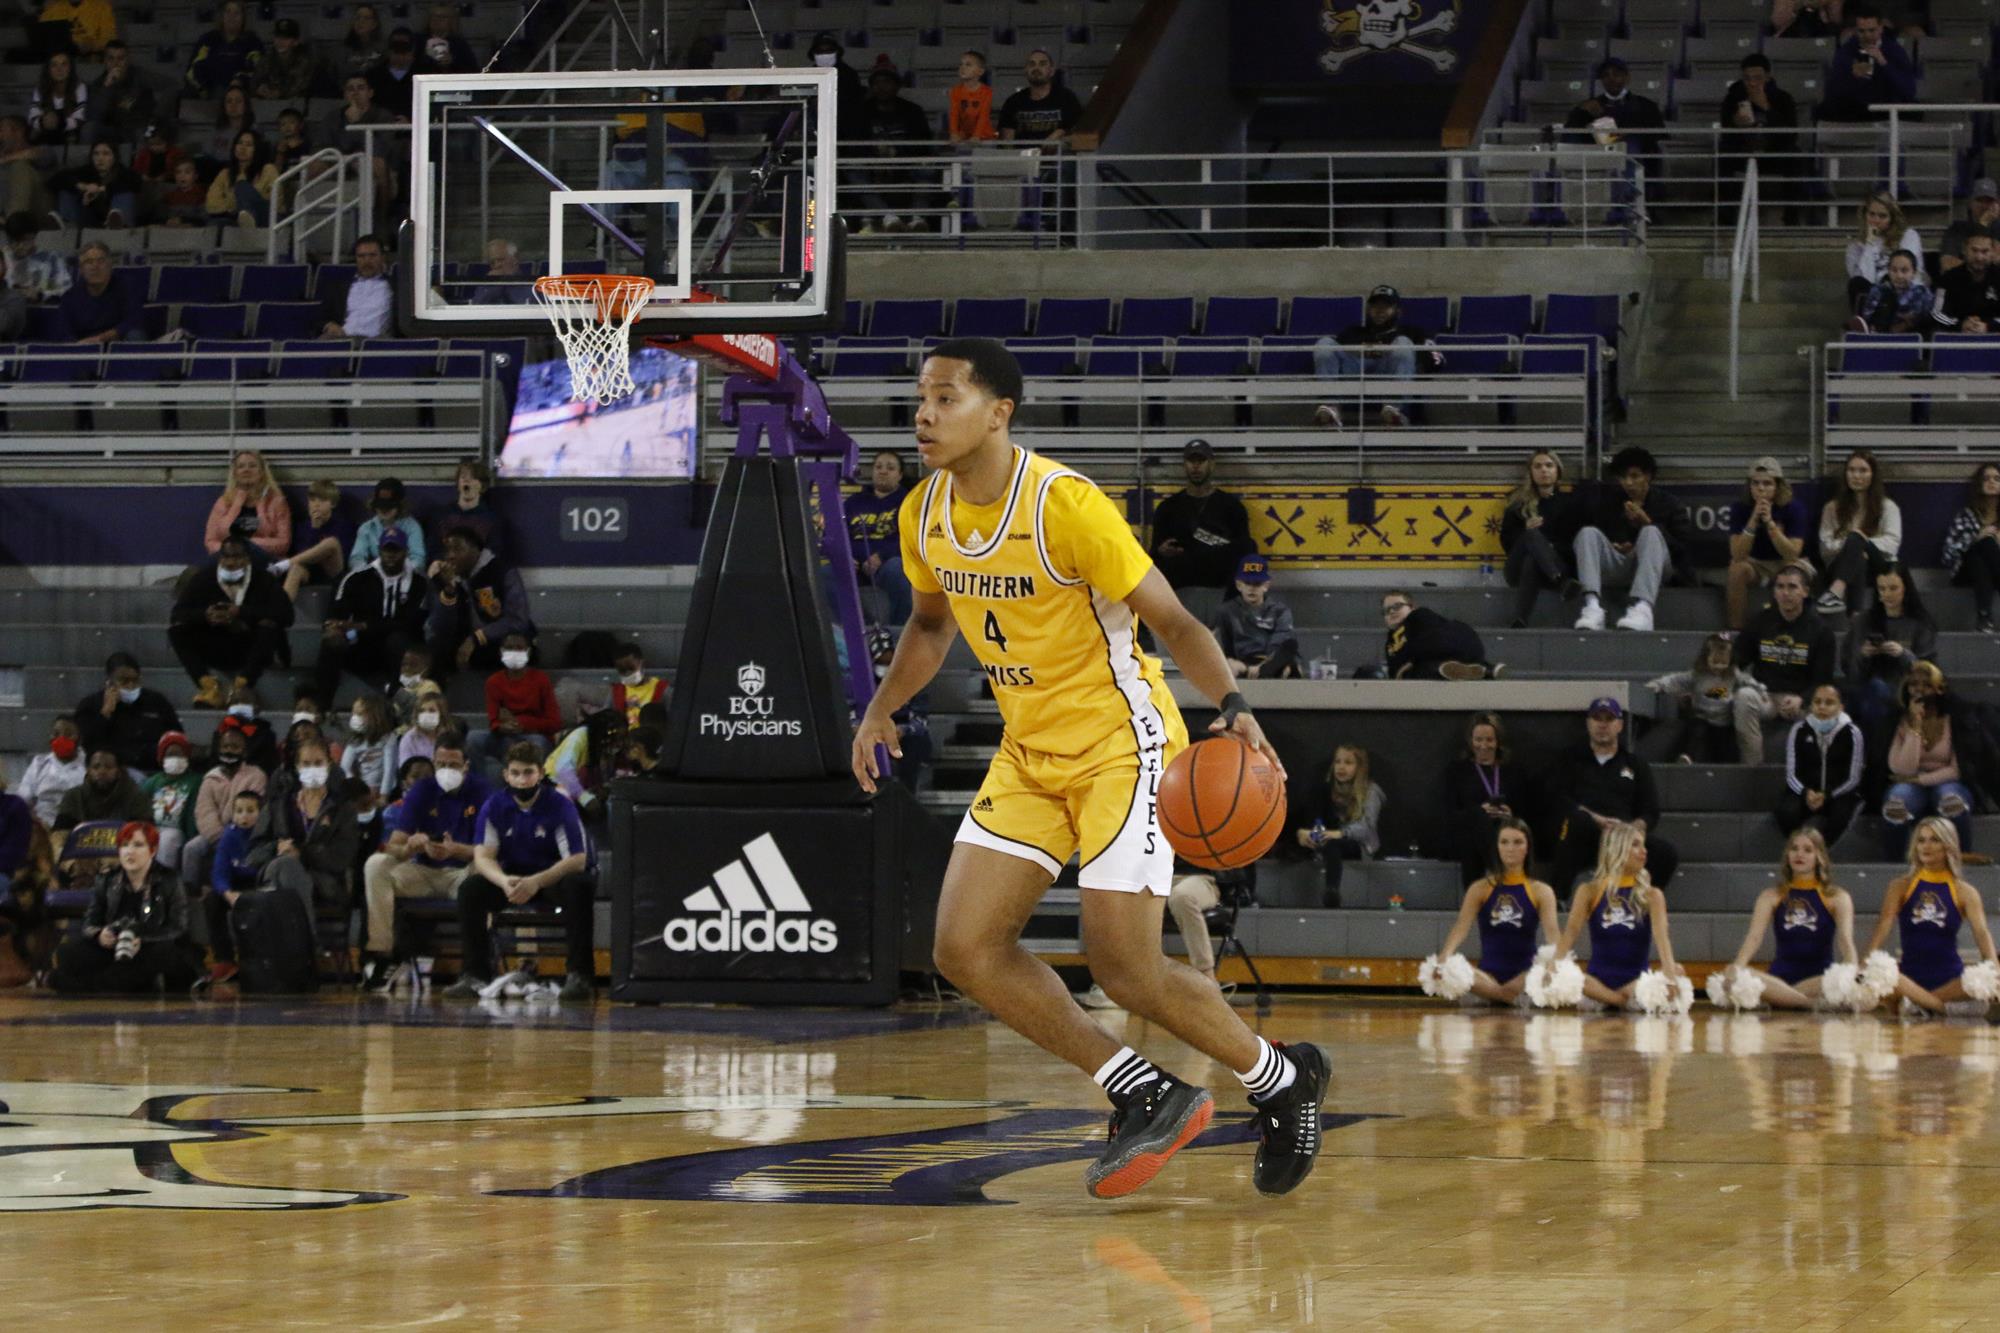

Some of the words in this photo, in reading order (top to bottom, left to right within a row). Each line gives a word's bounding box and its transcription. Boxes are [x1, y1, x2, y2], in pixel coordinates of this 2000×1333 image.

[567, 507, 621, 531] 102
[1243, 563, 1264, 572] ECU
[935, 567, 1036, 599] SOUTHERN
[984, 608, 1008, 653] 4
[985, 664, 1035, 687] MISS
[729, 697, 774, 715] ECU
[700, 714, 802, 741] Physicians
[663, 909, 839, 954] adidas
